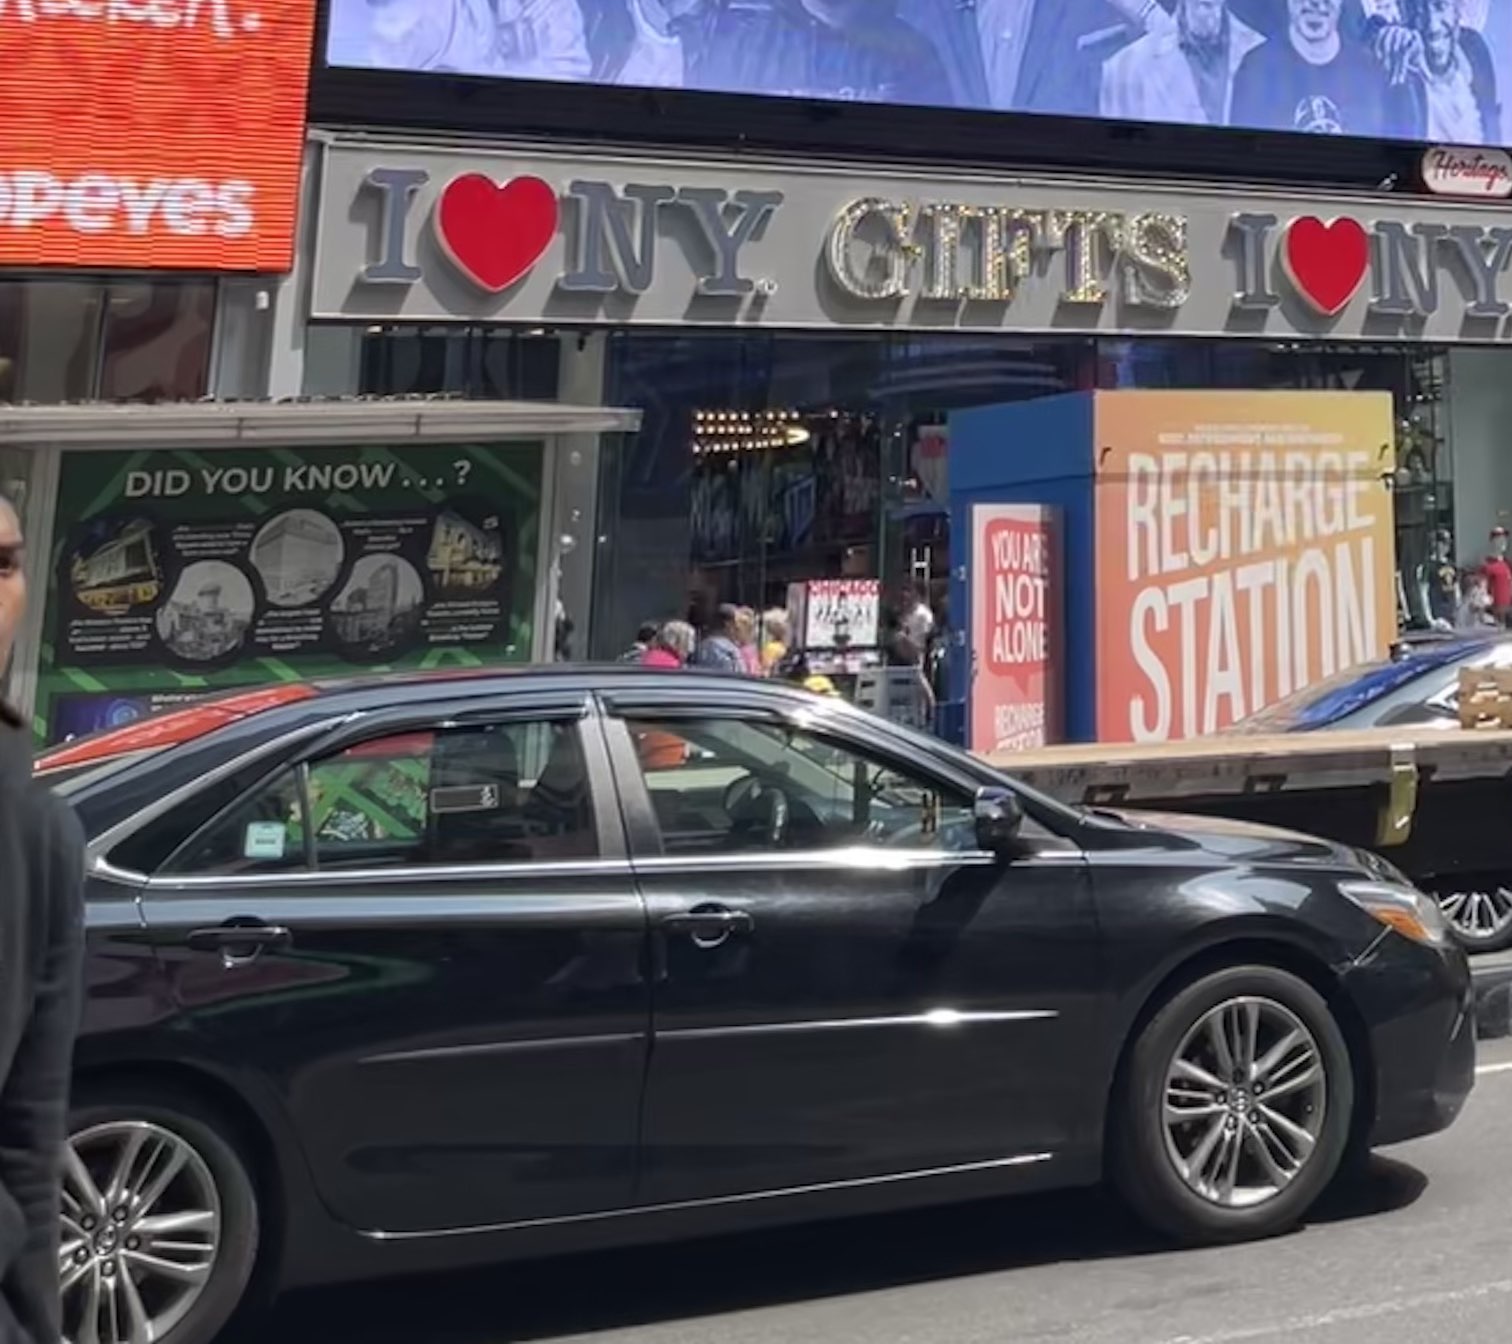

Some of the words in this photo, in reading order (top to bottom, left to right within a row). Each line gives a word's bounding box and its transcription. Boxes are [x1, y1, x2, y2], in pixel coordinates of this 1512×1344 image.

[825, 196, 1192, 309] GIFTS
[125, 470, 190, 497] DID
[202, 467, 273, 494] YOU
[283, 463, 396, 491] KNOW
[1127, 450, 1377, 582] RECHARGE
[991, 529, 1021, 572] YOU
[1023, 532, 1049, 576] ARE
[995, 572, 1049, 624] NOT
[993, 622, 1049, 664] ALONE
[1128, 536, 1378, 744] STATION
